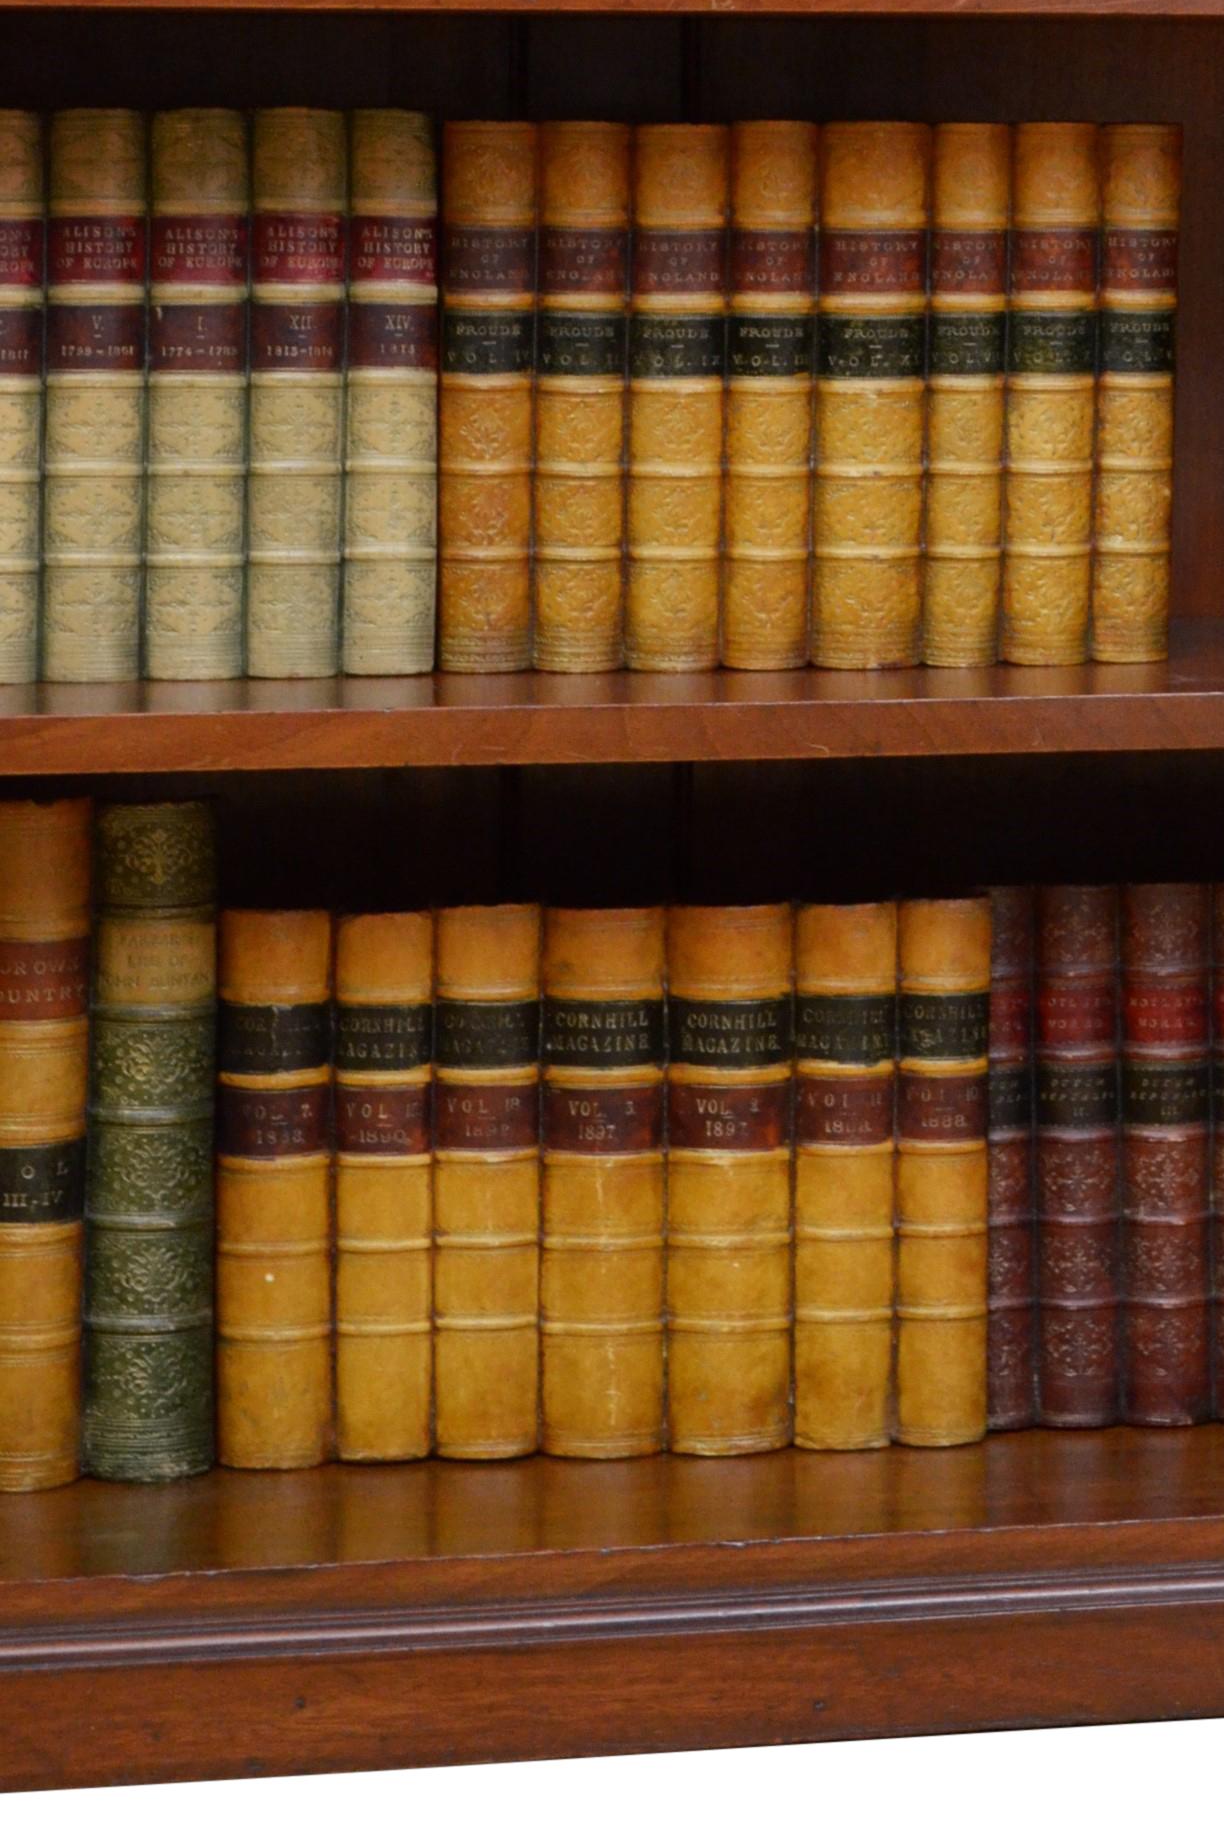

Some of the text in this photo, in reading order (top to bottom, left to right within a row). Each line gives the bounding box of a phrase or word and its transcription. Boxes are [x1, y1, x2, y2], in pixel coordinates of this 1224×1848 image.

[166, 242, 237, 255] HISTORY
[268, 240, 336, 253] HISTORY
[364, 241, 430, 254] HISTORY
[456, 324, 521, 336] FROUDE
[740, 327, 804, 338] FROUDE
[555, 1010, 650, 1030] CORNHILL
[687, 1010, 777, 1031] CORNHILL
[551, 1033, 650, 1053] MAGAZINE
[681, 1034, 781, 1054] MAGAZINE
[447, 1097, 489, 1114] VOL
